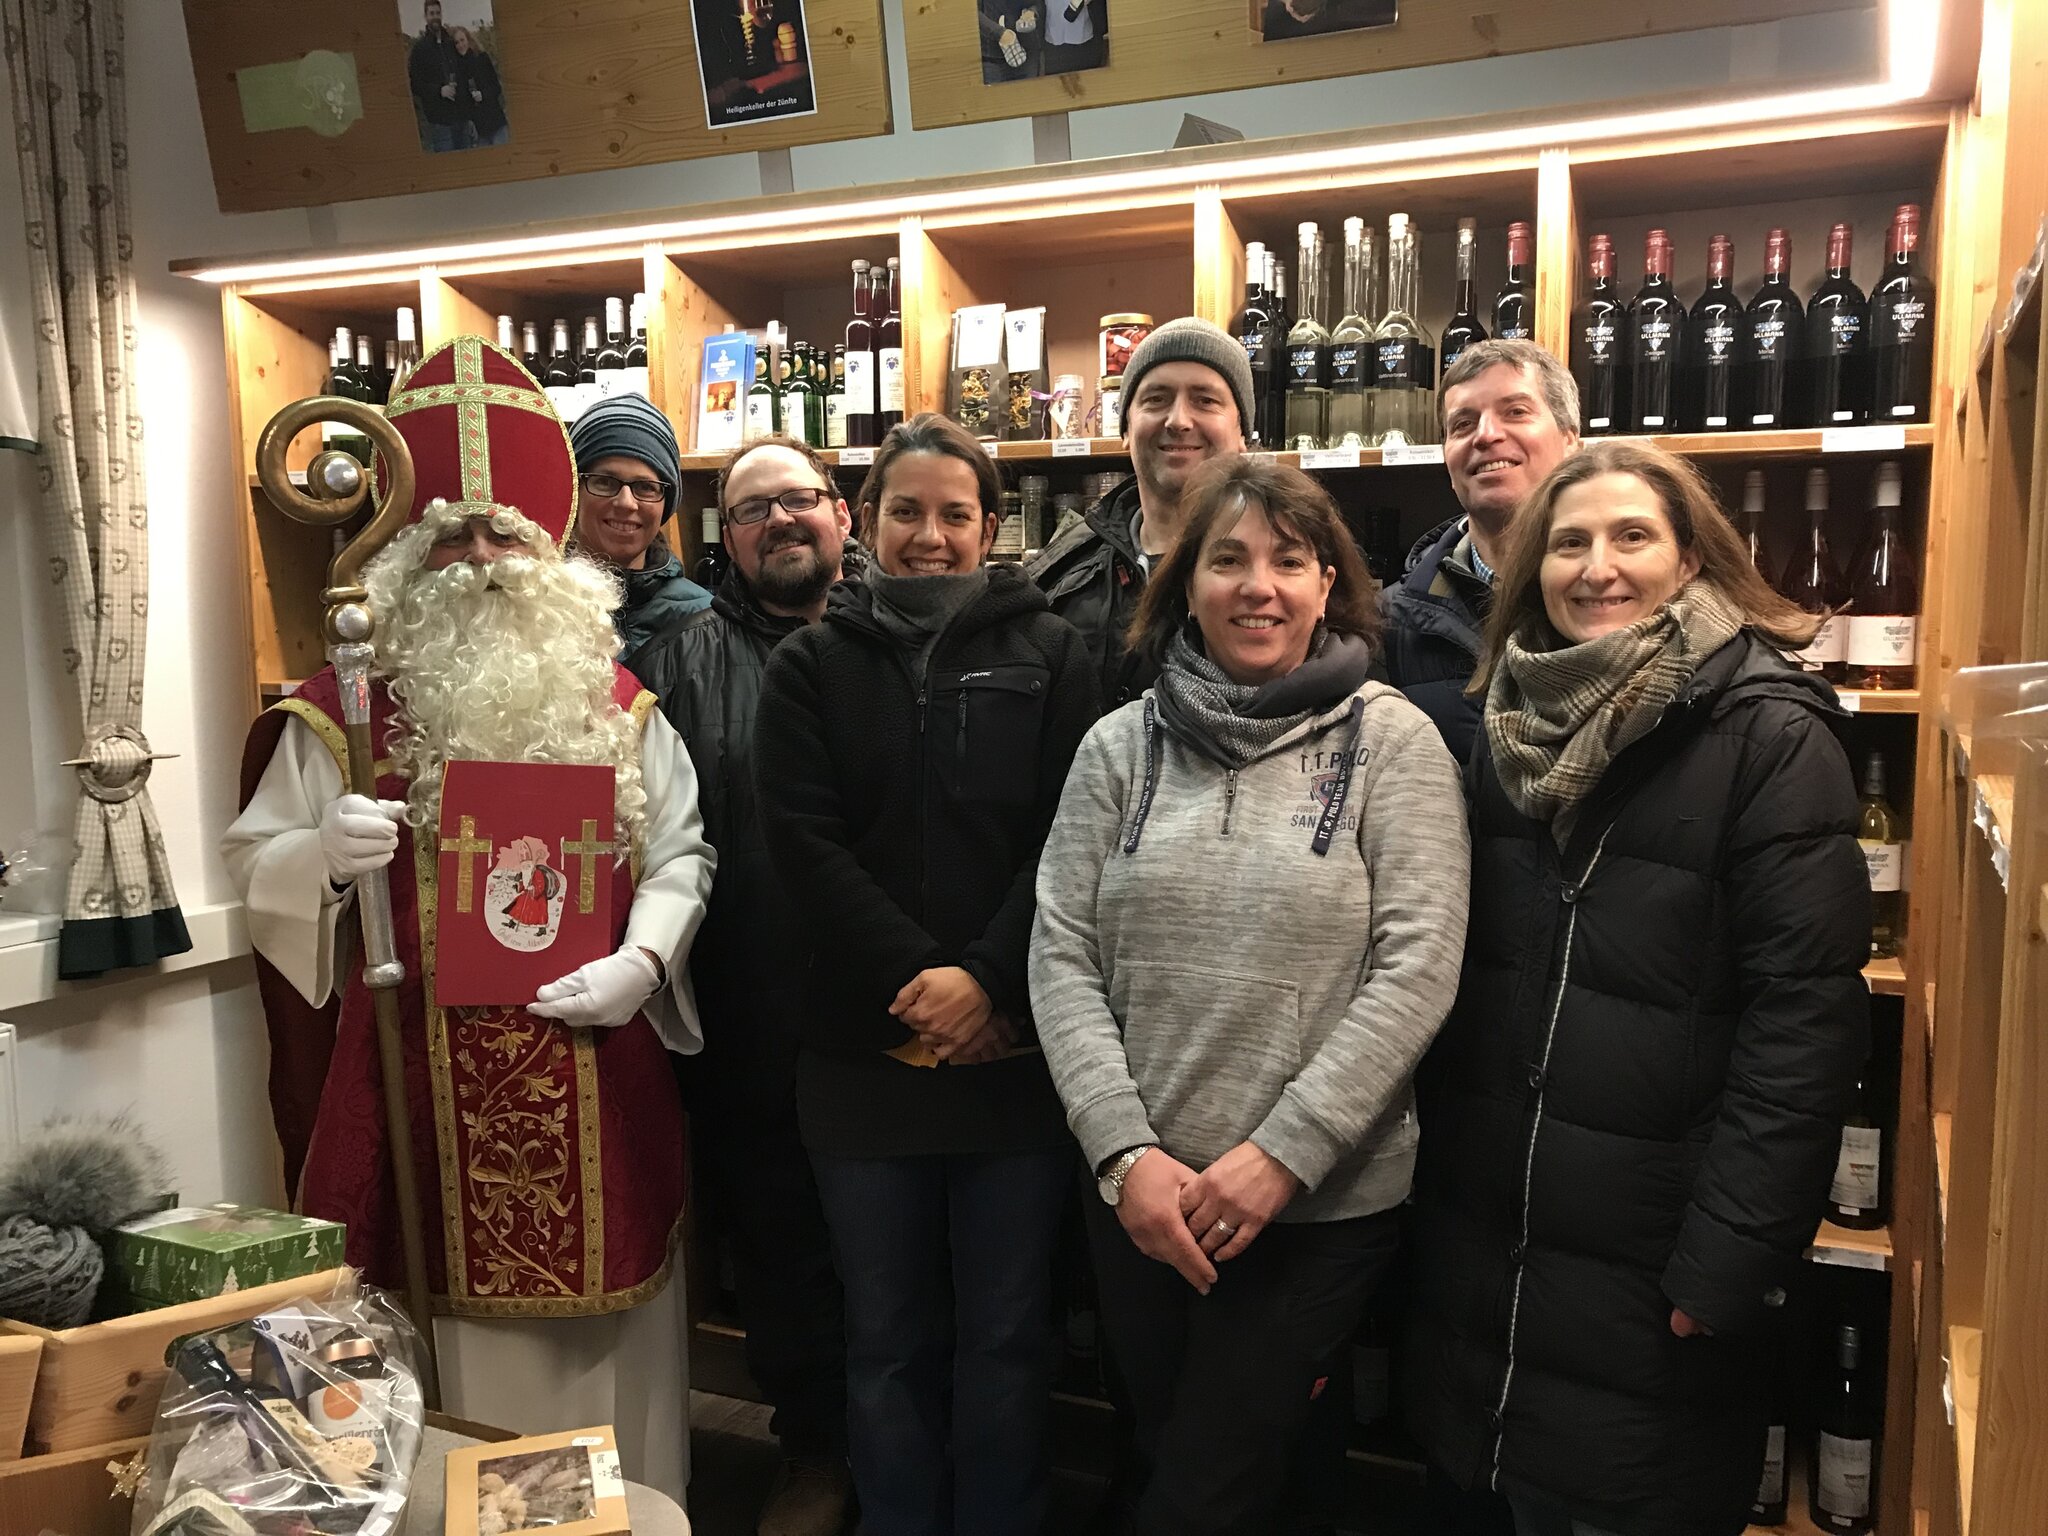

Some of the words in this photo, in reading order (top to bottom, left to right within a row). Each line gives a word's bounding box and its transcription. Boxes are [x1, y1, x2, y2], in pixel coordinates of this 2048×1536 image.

[726, 102, 765, 114] Heiligenkeller
[766, 100, 777, 108] der
[777, 97, 798, 107] Zünfte
[1327, 801, 1340, 818] POLO
[1334, 782, 1345, 801] TEAM
[1296, 805, 1319, 813] FIRST
[1290, 814, 1317, 829] SAN
